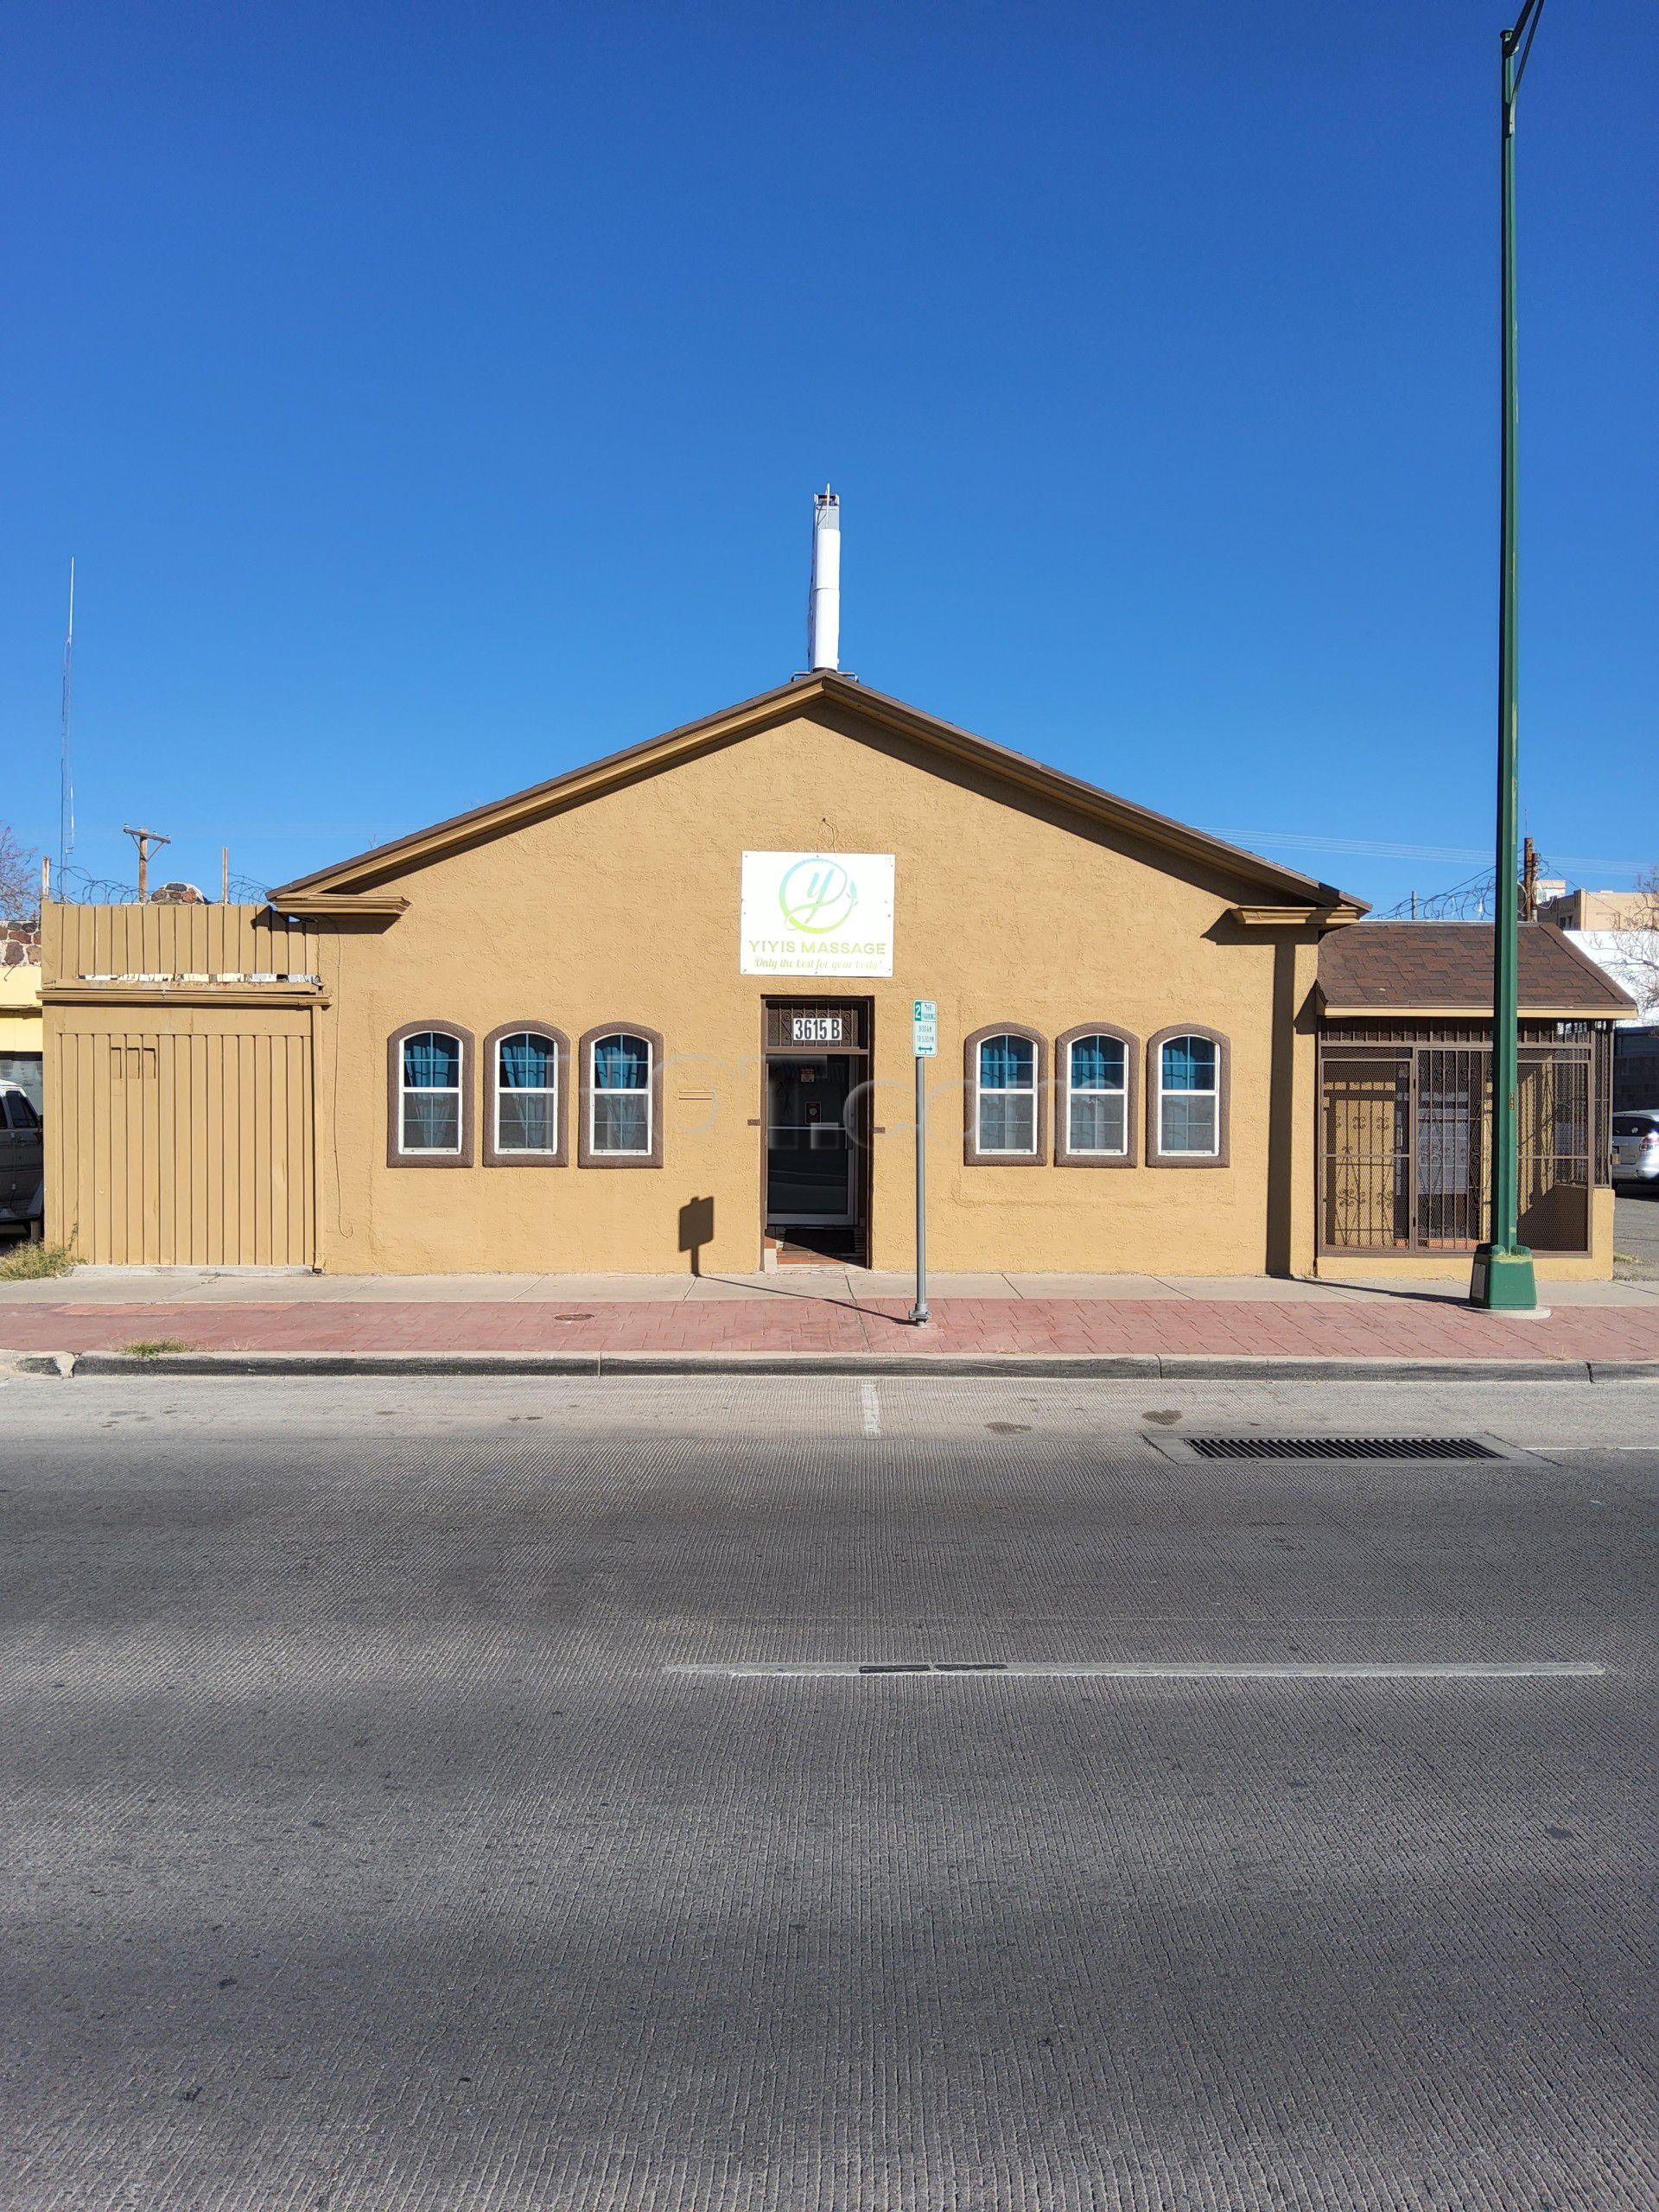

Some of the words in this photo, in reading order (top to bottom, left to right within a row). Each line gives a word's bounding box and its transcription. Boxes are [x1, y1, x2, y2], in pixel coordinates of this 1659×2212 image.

[748, 940, 796, 953] YIYIS
[801, 941, 886, 955] MASSAGE
[779, 958, 793, 969] the
[796, 958, 814, 969] best
[815, 959, 828, 970] for
[831, 962, 852, 971] your
[916, 1005, 921, 1018] 2
[795, 1019, 828, 1039] 3615
[831, 1019, 840, 1039] B
